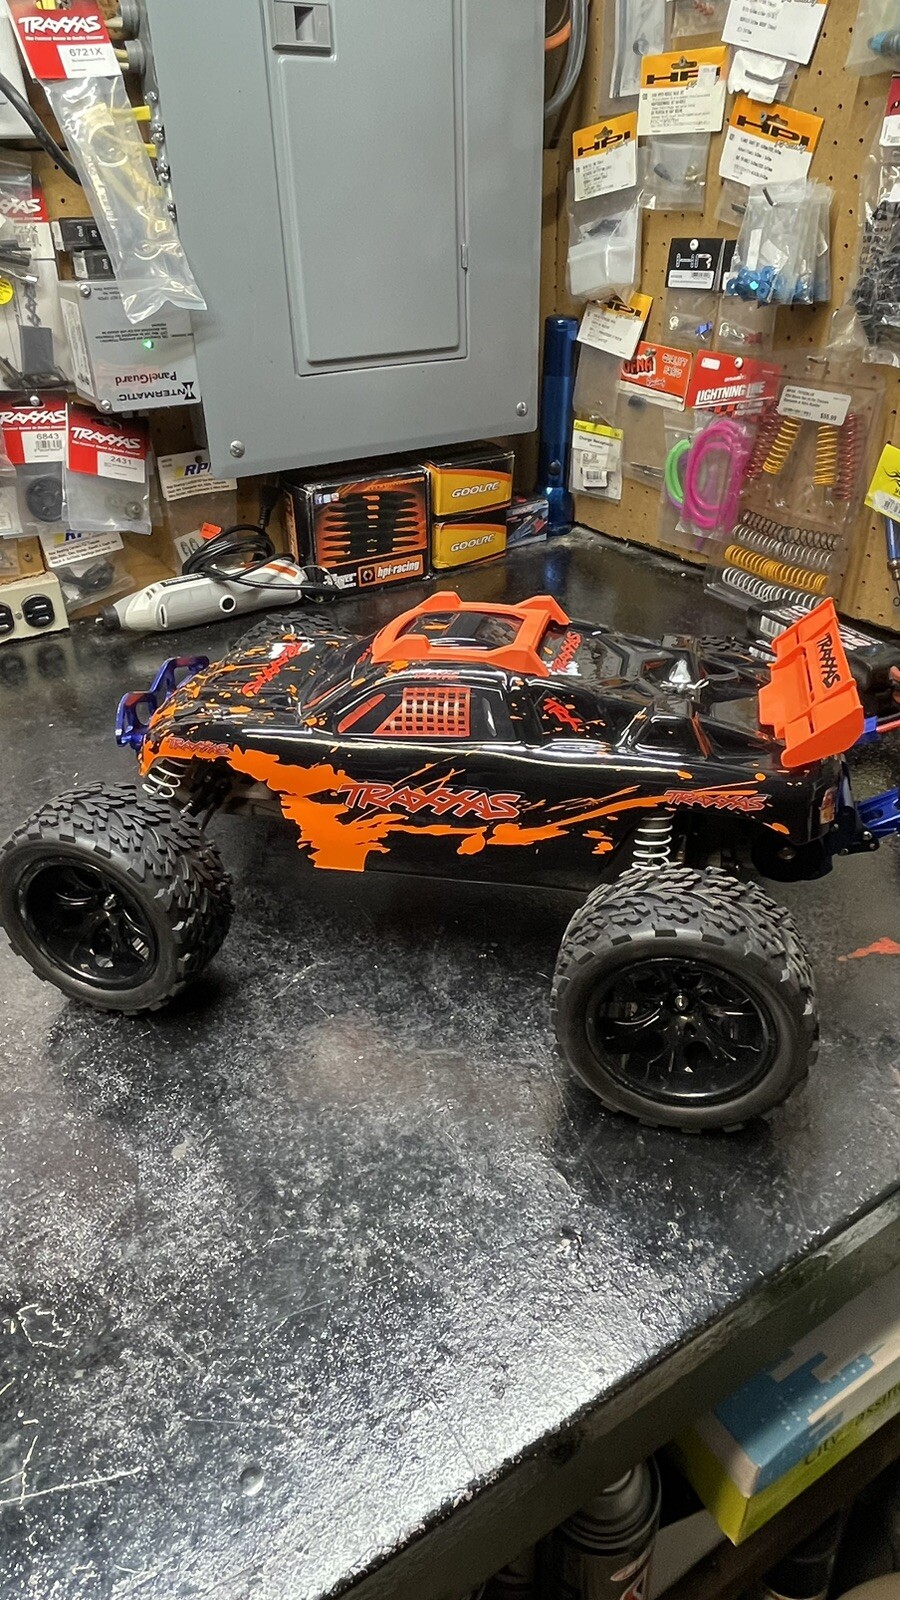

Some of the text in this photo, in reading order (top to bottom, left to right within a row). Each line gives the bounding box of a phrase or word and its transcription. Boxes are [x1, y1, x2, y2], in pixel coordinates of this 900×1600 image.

[18, 15, 101, 34] TRAXXAS
[69, 47, 103, 57] 6721X
[736, 114, 811, 147] HPI
[577, 130, 631, 157] HPI
[114, 371, 177, 387] PanelGuard
[117, 381, 197, 402] INTERMATIC
[695, 384, 748, 406] LIGHTNING
[36, 432, 59, 440] 6843
[71, 426, 140, 449] TRAXXAS
[110, 455, 132, 465] 2431
[184, 462, 212, 476] RP
[451, 481, 500, 499] GOOLRC
[450, 533, 495, 553] GOOLRC
[377, 561, 420, 580] hpi-racing
[816, 632, 841, 689] TRAXXAS
[168, 736, 230, 755] TRAXXAS
[337, 783, 522, 820] TRAXXAS
[664, 789, 771, 812] TRAXXAS
